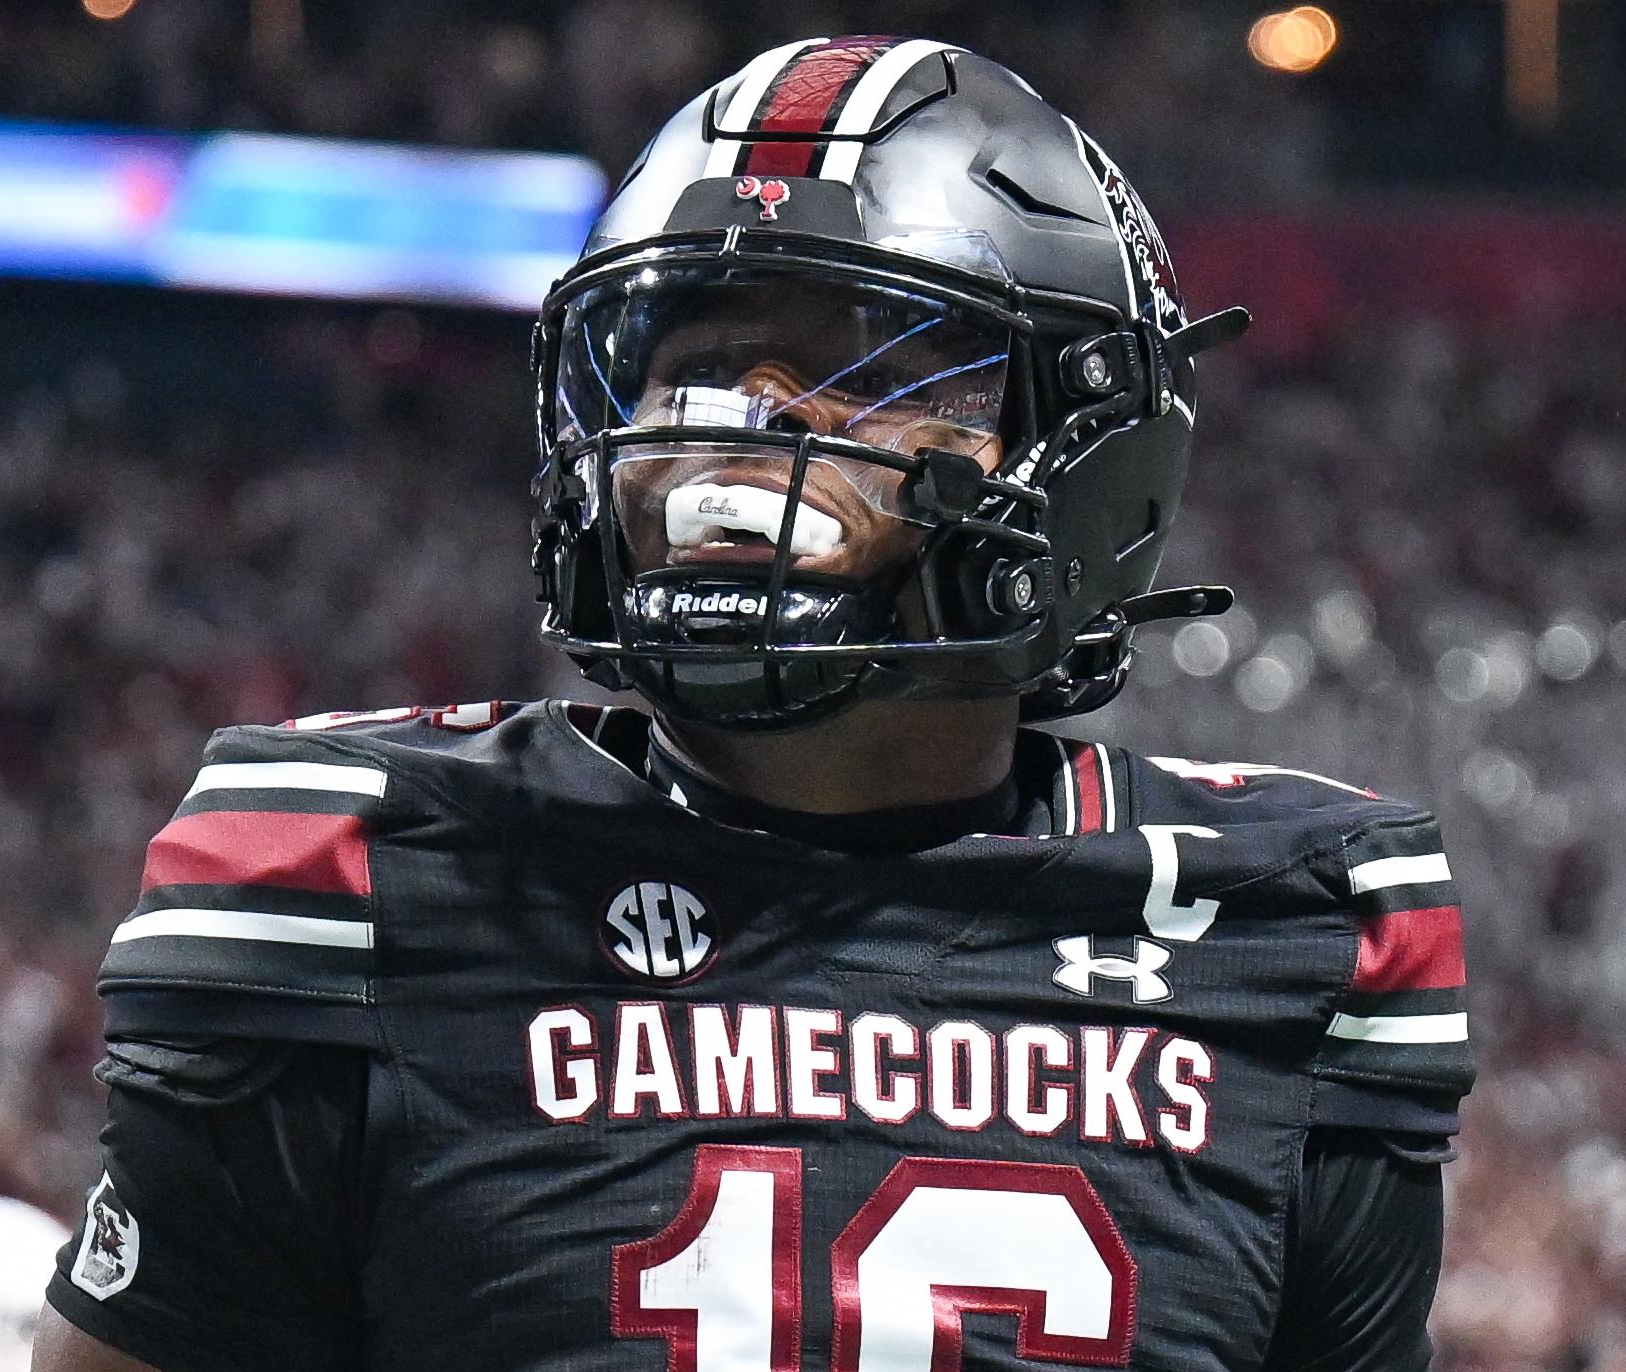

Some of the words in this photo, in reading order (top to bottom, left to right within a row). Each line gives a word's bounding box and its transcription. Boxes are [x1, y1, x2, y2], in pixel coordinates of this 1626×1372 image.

[698, 497, 738, 517] Carolina
[672, 592, 768, 616] Riddel
[606, 881, 712, 978] SEC
[1138, 824, 1223, 943] C
[527, 1001, 1214, 1154] GAMECOCKS
